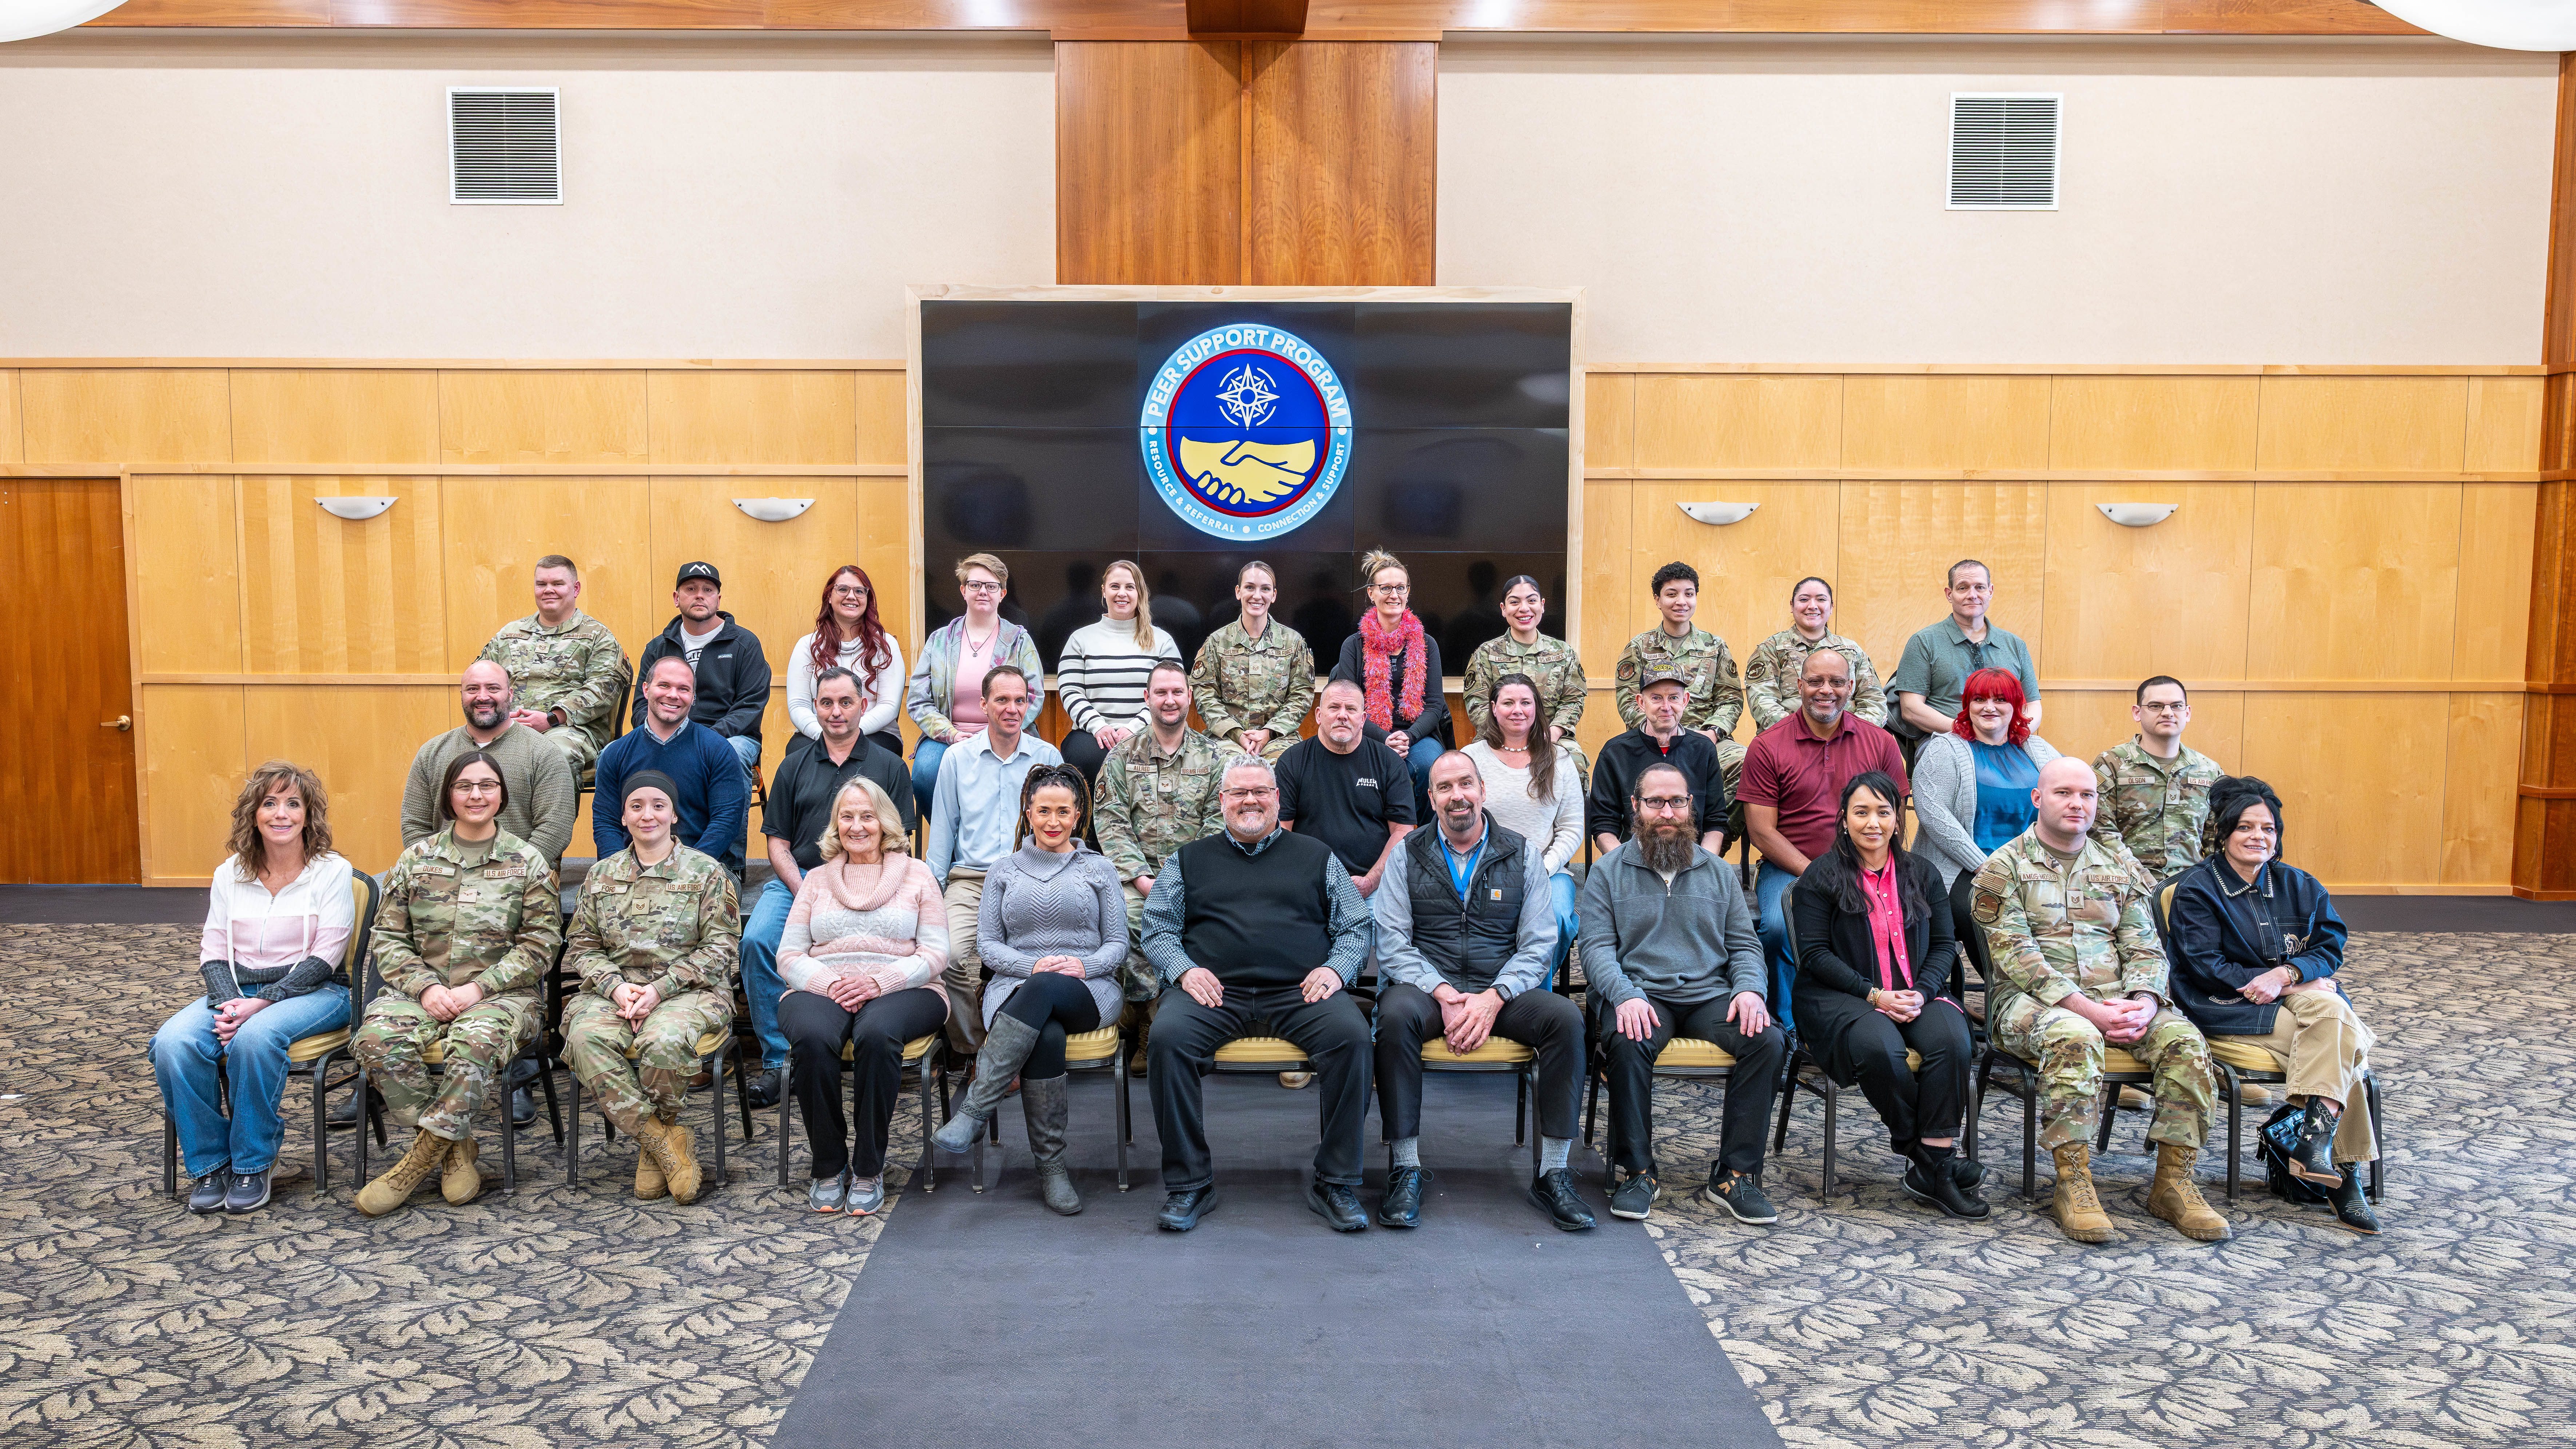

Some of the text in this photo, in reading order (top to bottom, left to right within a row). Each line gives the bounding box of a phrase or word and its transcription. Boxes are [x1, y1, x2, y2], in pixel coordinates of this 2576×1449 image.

[1147, 329, 1348, 418] PEER SUPPORT PROGRAM
[1149, 441, 1235, 533] RESOURCE & REFERRAL
[1257, 442, 1345, 533] CONNECTION & SUPPORT
[422, 865, 443, 873] DUKES
[506, 868, 524, 876] FORCE
[687, 883, 702, 891] FORCE
